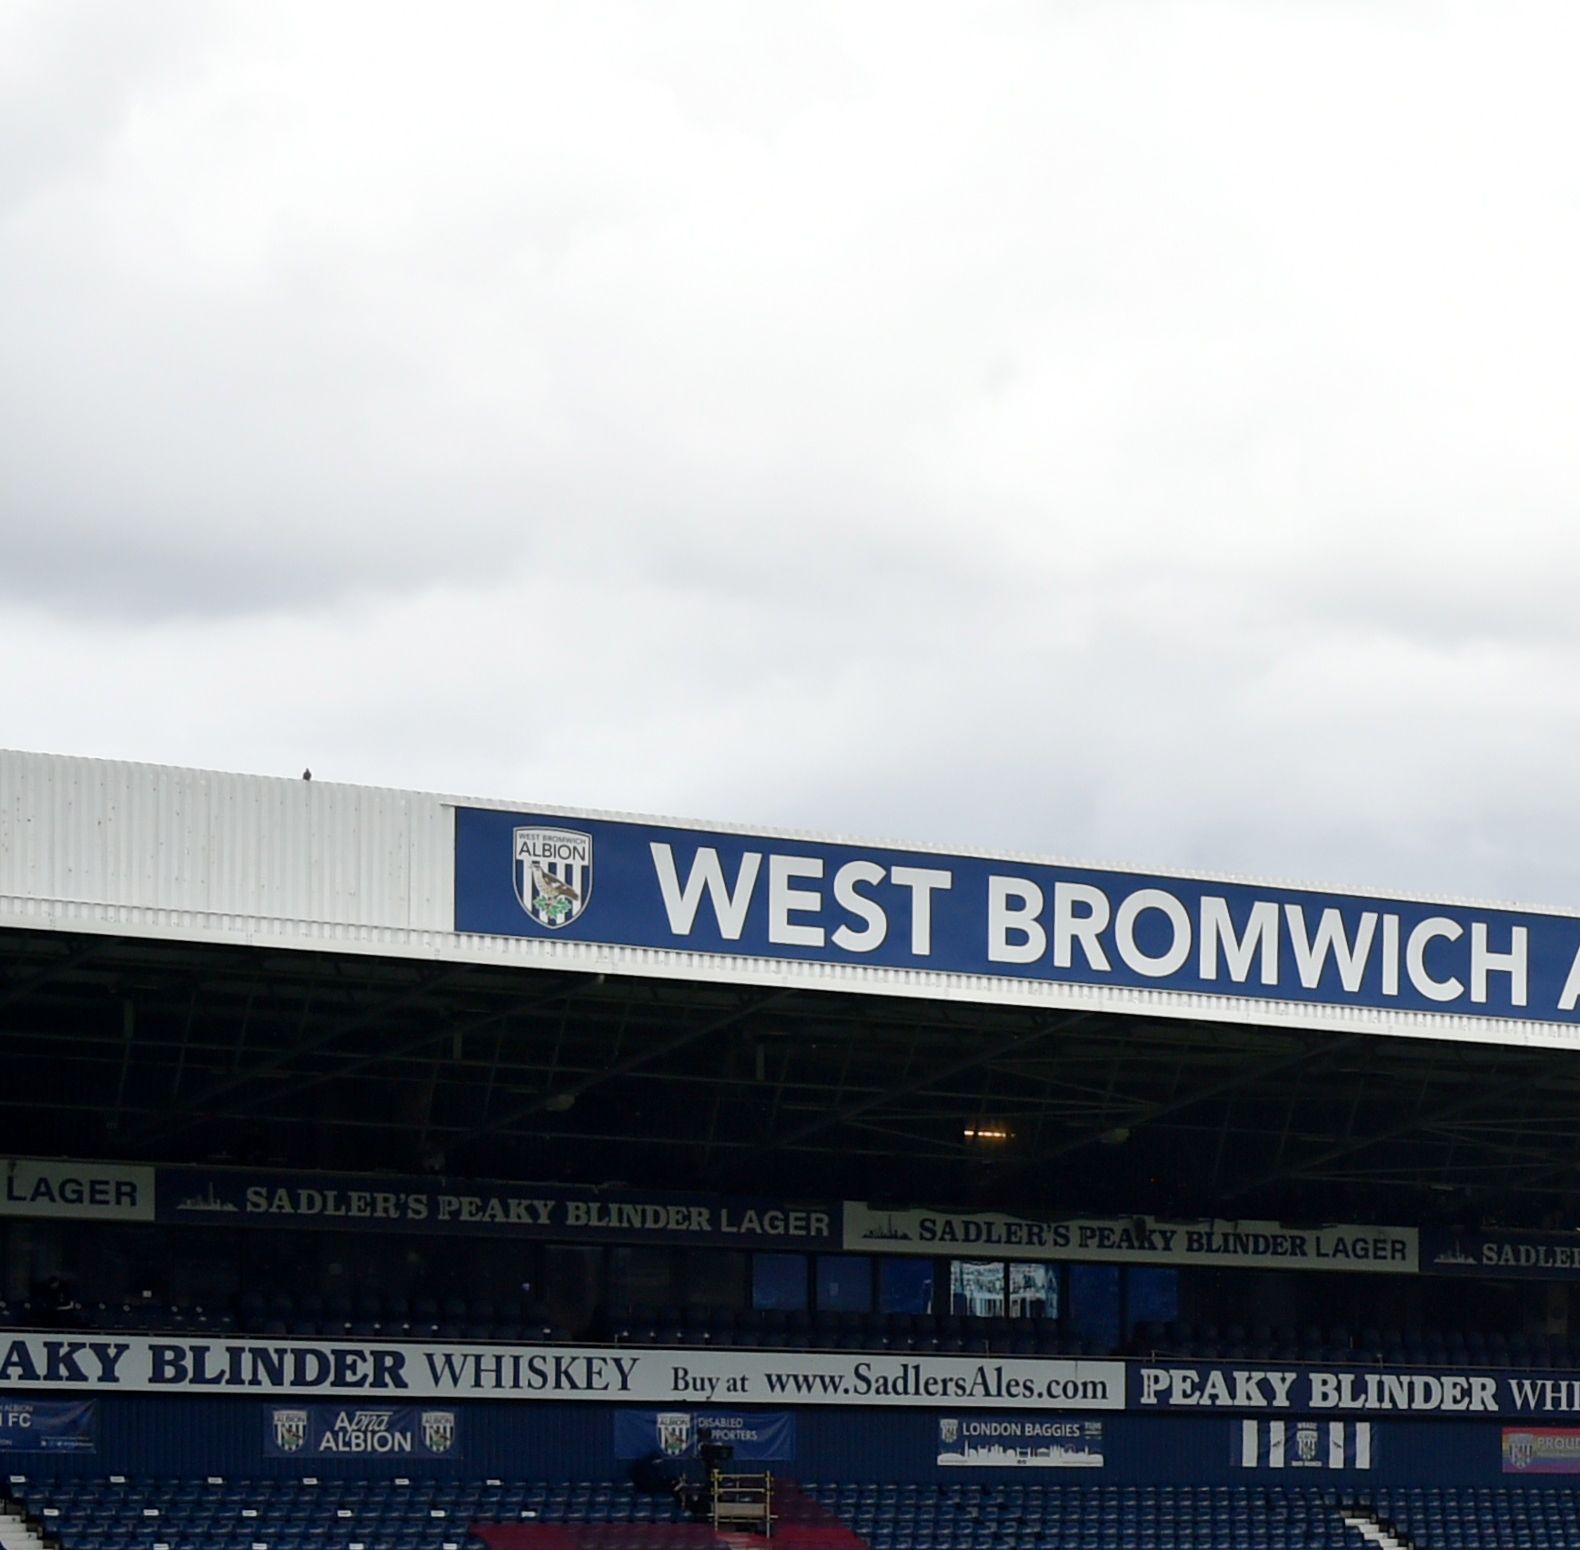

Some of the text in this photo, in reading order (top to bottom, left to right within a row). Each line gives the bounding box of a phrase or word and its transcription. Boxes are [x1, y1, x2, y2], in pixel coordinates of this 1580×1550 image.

[519, 841, 586, 862] ALBION
[650, 840, 952, 956] WEST
[987, 872, 1529, 1007] BROMWICH
[6, 1174, 138, 1207] LAGER
[245, 1184, 831, 1238] SADLER'S PEAKY BLINDER LAGER
[918, 1218, 1407, 1261] SADLER'S PEAKY BLINDER LAGER
[0, 1340, 1109, 1402] AKY BLINDER WHISKEY Buy at www.SadlersAles.com
[1139, 1367, 1297, 1408] PEAKY
[1308, 1371, 1500, 1412] BLINDER
[8, 1412, 32, 1428] FC
[697, 1416, 744, 1428] DISABLED
[962, 1421, 1022, 1437] LONDON
[1024, 1422, 1081, 1438] BAGGIES
[319, 1430, 412, 1453] ALBION
[710, 1429, 758, 1441] PPORTERS
